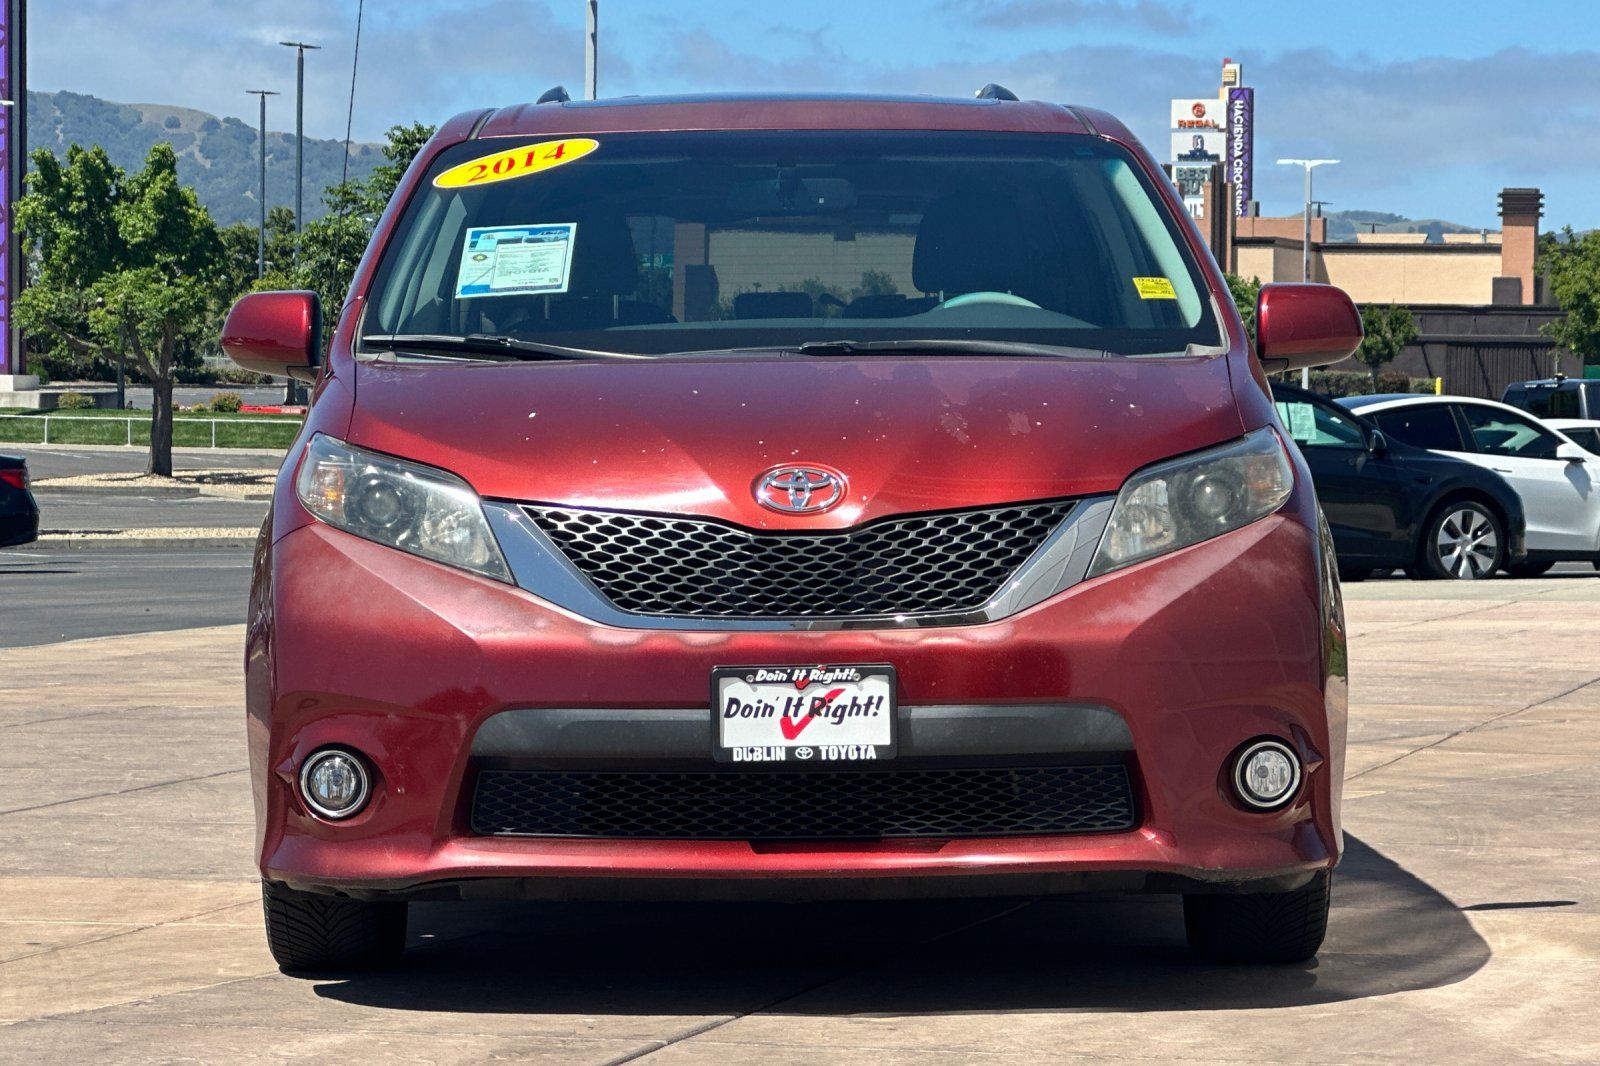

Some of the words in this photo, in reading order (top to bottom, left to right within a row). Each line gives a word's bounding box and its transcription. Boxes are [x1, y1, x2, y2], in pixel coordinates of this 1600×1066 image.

[1233, 100, 1244, 158] HACIENDA
[467, 143, 567, 182] 2014
[1233, 159, 1244, 216] CROSSING
[756, 669, 791, 682] Doin'
[791, 669, 808, 682] It
[809, 668, 854, 685] Right!
[724, 696, 780, 719] Doin'
[782, 696, 805, 718] It
[808, 695, 884, 725] Right!
[732, 747, 786, 762] DUBLIN
[819, 745, 877, 761] TOYOTA
